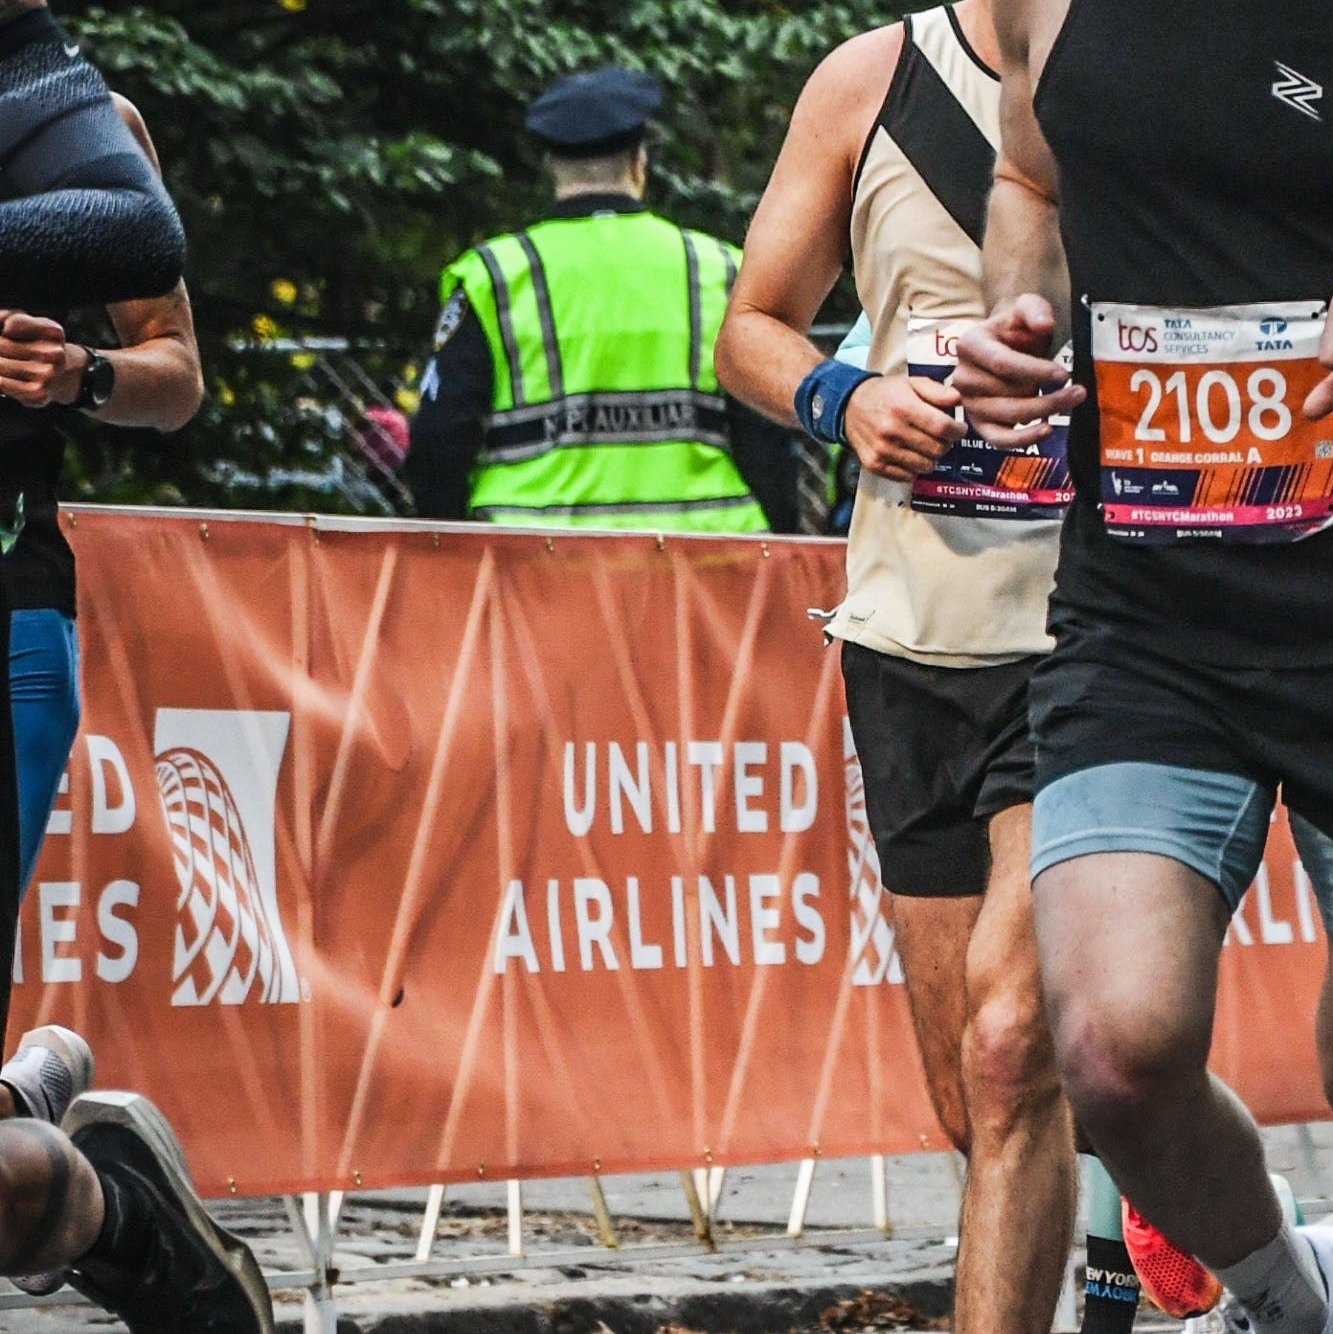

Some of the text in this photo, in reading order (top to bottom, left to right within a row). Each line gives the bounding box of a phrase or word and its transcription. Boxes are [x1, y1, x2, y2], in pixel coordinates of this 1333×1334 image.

[1164, 319, 1191, 329] TATA
[1164, 330, 1235, 341] CONSULTANCY
[1164, 344, 1209, 354] SERVICES
[1255, 340, 1294, 351] TATA
[1130, 368, 1292, 444] 2108
[961, 439, 983, 450] BLUE
[1136, 448, 1144, 464] 1
[1247, 447, 1262, 465] A
[1266, 506, 1303, 519] 2023
[564, 740, 819, 837] UNITED
[493, 872, 827, 975] AIRLINES
